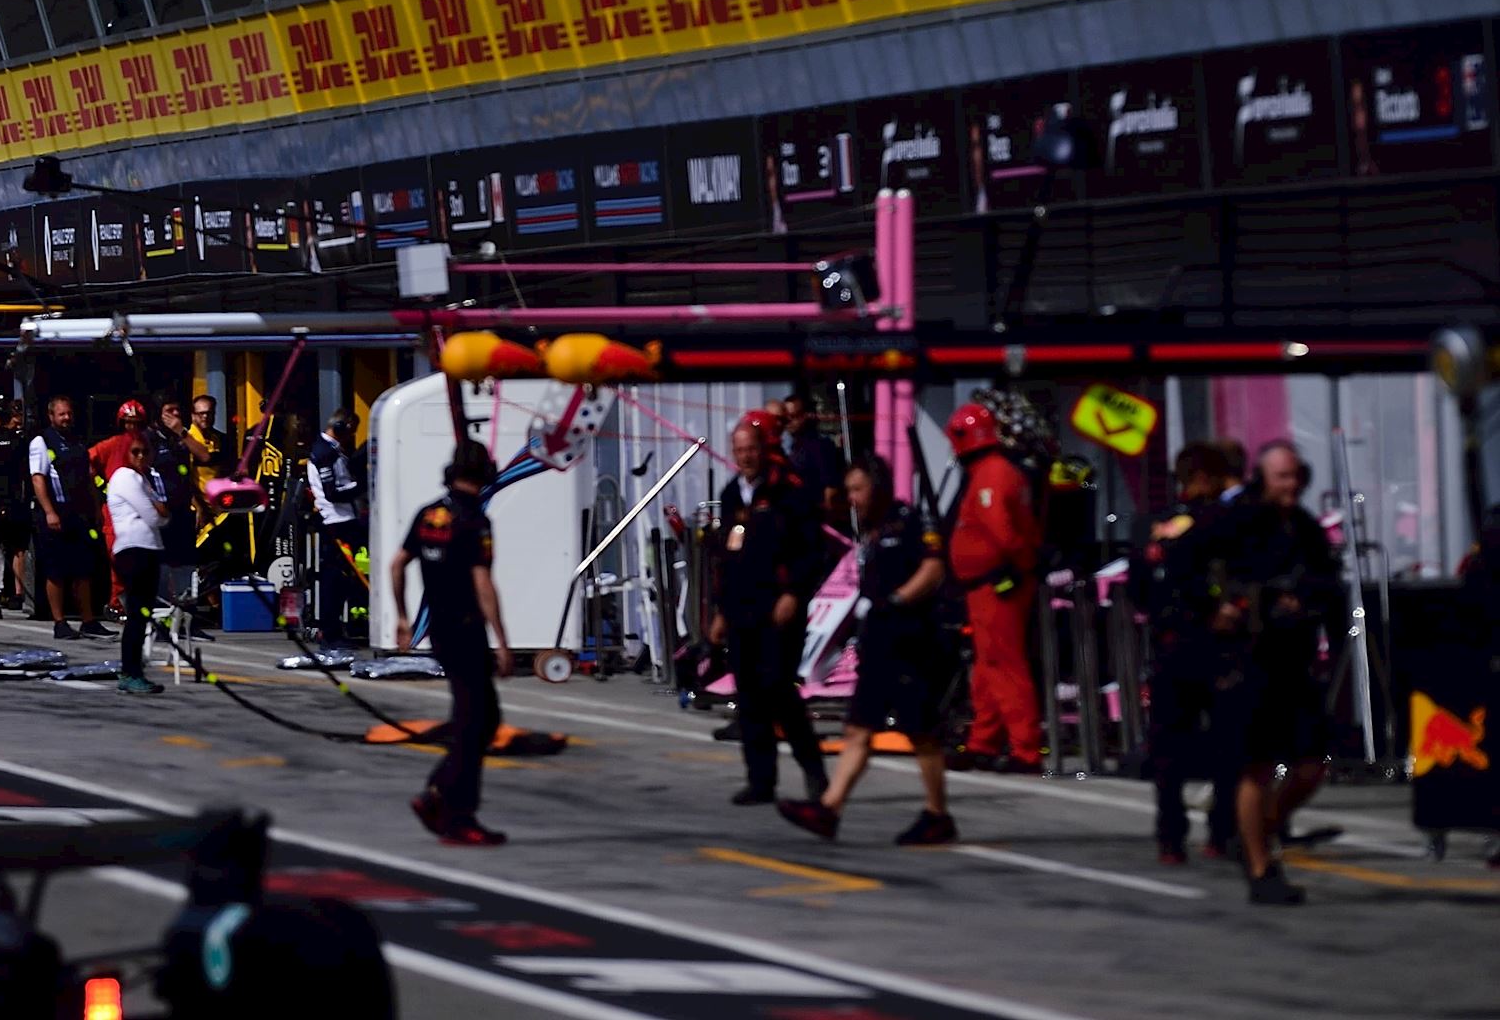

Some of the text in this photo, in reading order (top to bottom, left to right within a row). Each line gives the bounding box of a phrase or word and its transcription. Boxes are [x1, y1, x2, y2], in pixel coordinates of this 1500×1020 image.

[230, 34, 281, 104] DHL
[290, 22, 343, 94] DHL
[353, 8, 411, 83] DHL
